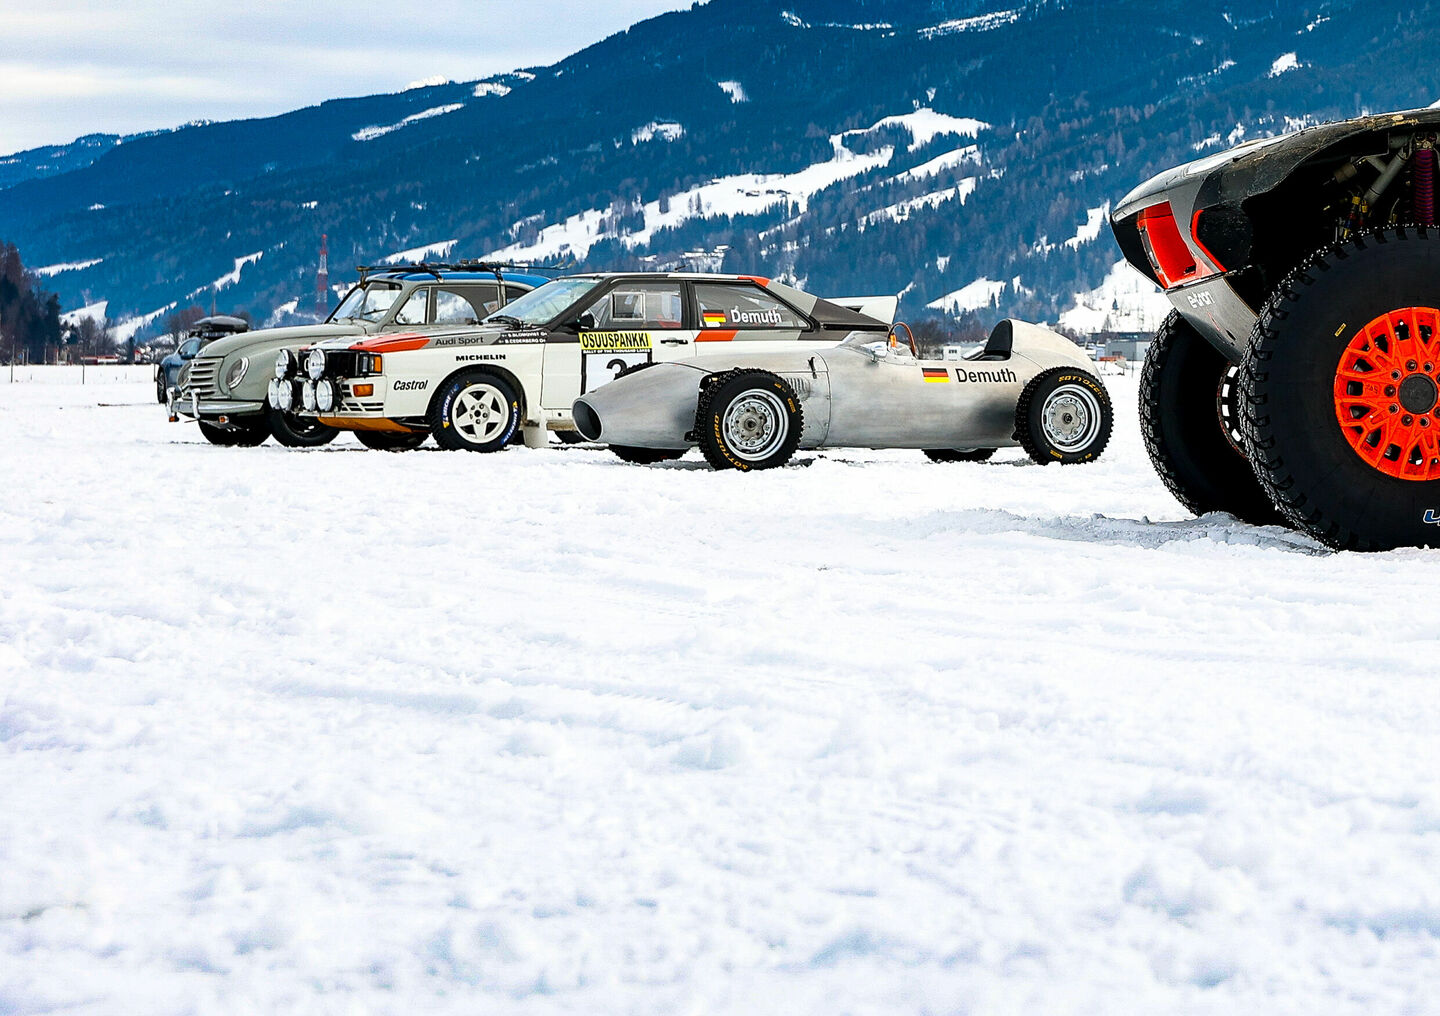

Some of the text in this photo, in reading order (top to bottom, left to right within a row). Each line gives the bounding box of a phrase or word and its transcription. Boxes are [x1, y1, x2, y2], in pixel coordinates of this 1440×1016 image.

[730, 309, 782, 323] Demuth
[435, 336, 484, 346] Audi Sport
[581, 332, 649, 348] OSUUSPANKKI
[955, 367, 1017, 382] Demuth
[393, 379, 429, 391] Castrol
